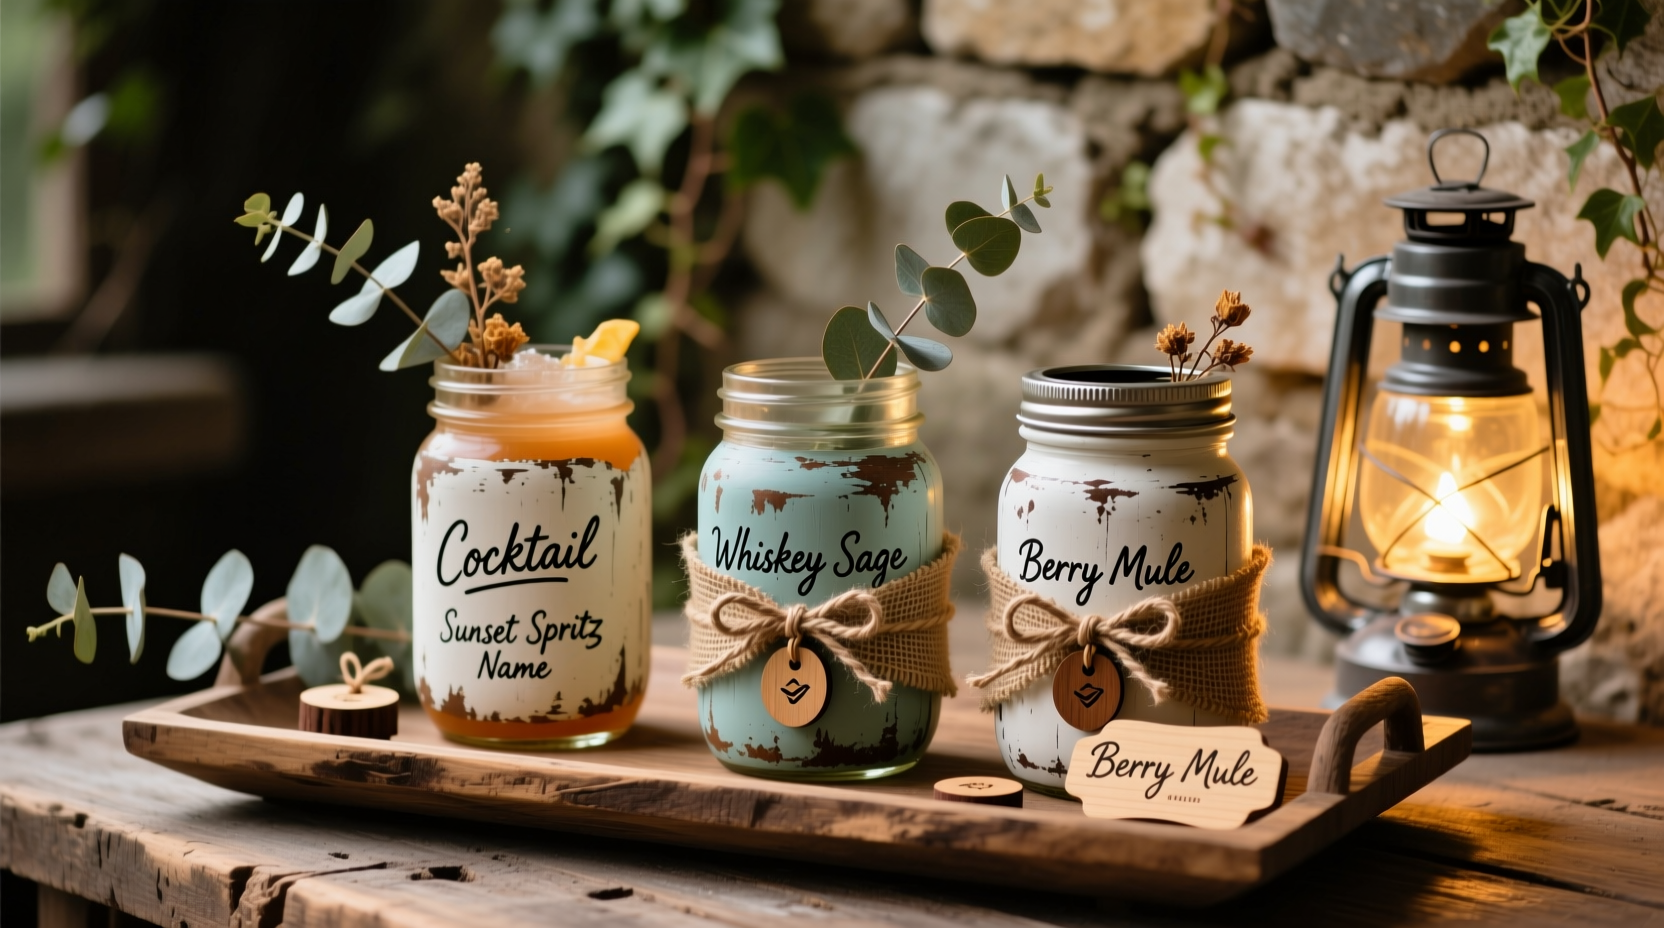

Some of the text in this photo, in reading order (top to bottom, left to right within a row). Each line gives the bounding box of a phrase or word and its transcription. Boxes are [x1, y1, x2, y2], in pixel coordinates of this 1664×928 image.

[436, 515, 600, 587] Cocktail
[711, 525, 908, 597] Whiskey Sage
[1018, 538, 1195, 606] Berry Mule
[440, 608, 603, 655] Sunset Spritz
[477, 650, 552, 680] Name
[1085, 741, 1258, 800] Berry Mule
